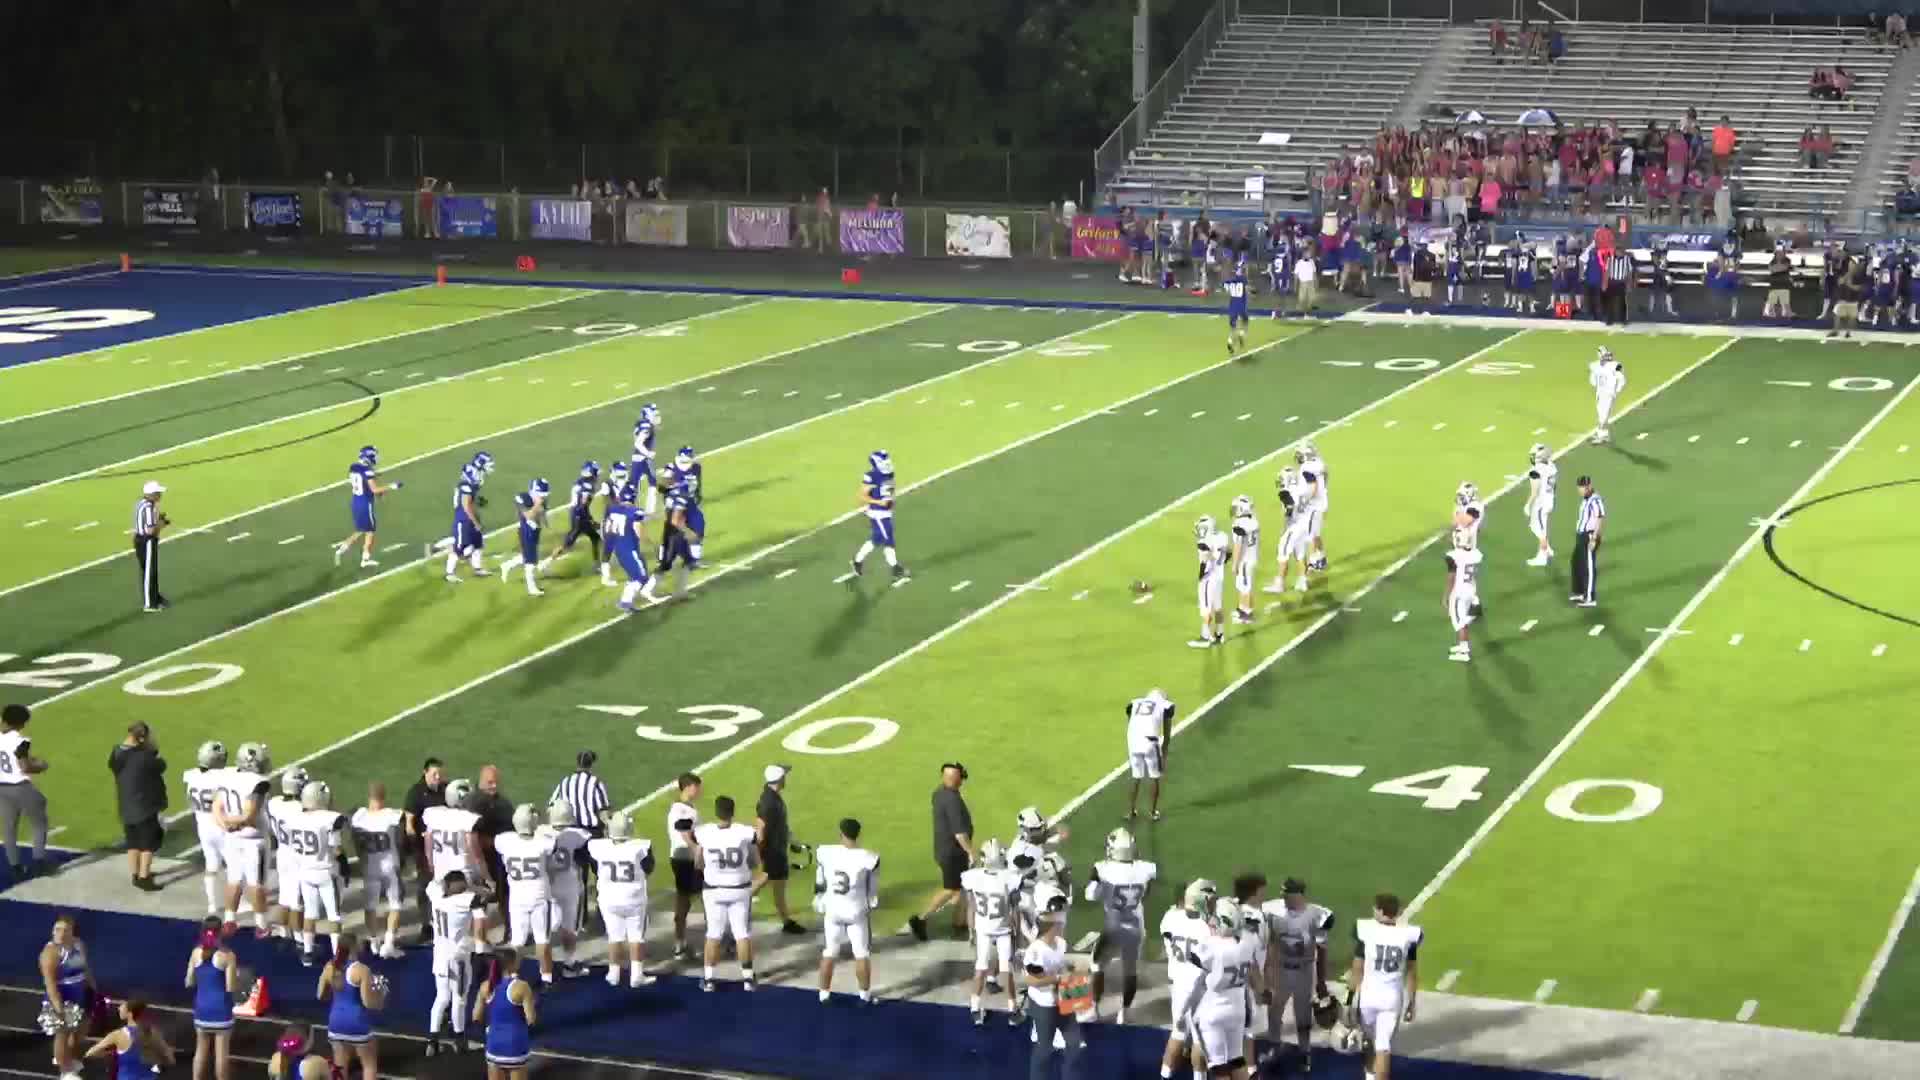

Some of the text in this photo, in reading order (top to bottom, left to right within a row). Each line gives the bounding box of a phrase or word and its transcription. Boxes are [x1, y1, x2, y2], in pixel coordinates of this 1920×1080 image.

[291, 829, 319, 856] 59
[601, 860, 636, 883] 73
[834, 870, 851, 896] 3
[974, 890, 1006, 920] 33
[1374, 944, 1404, 973] 18
